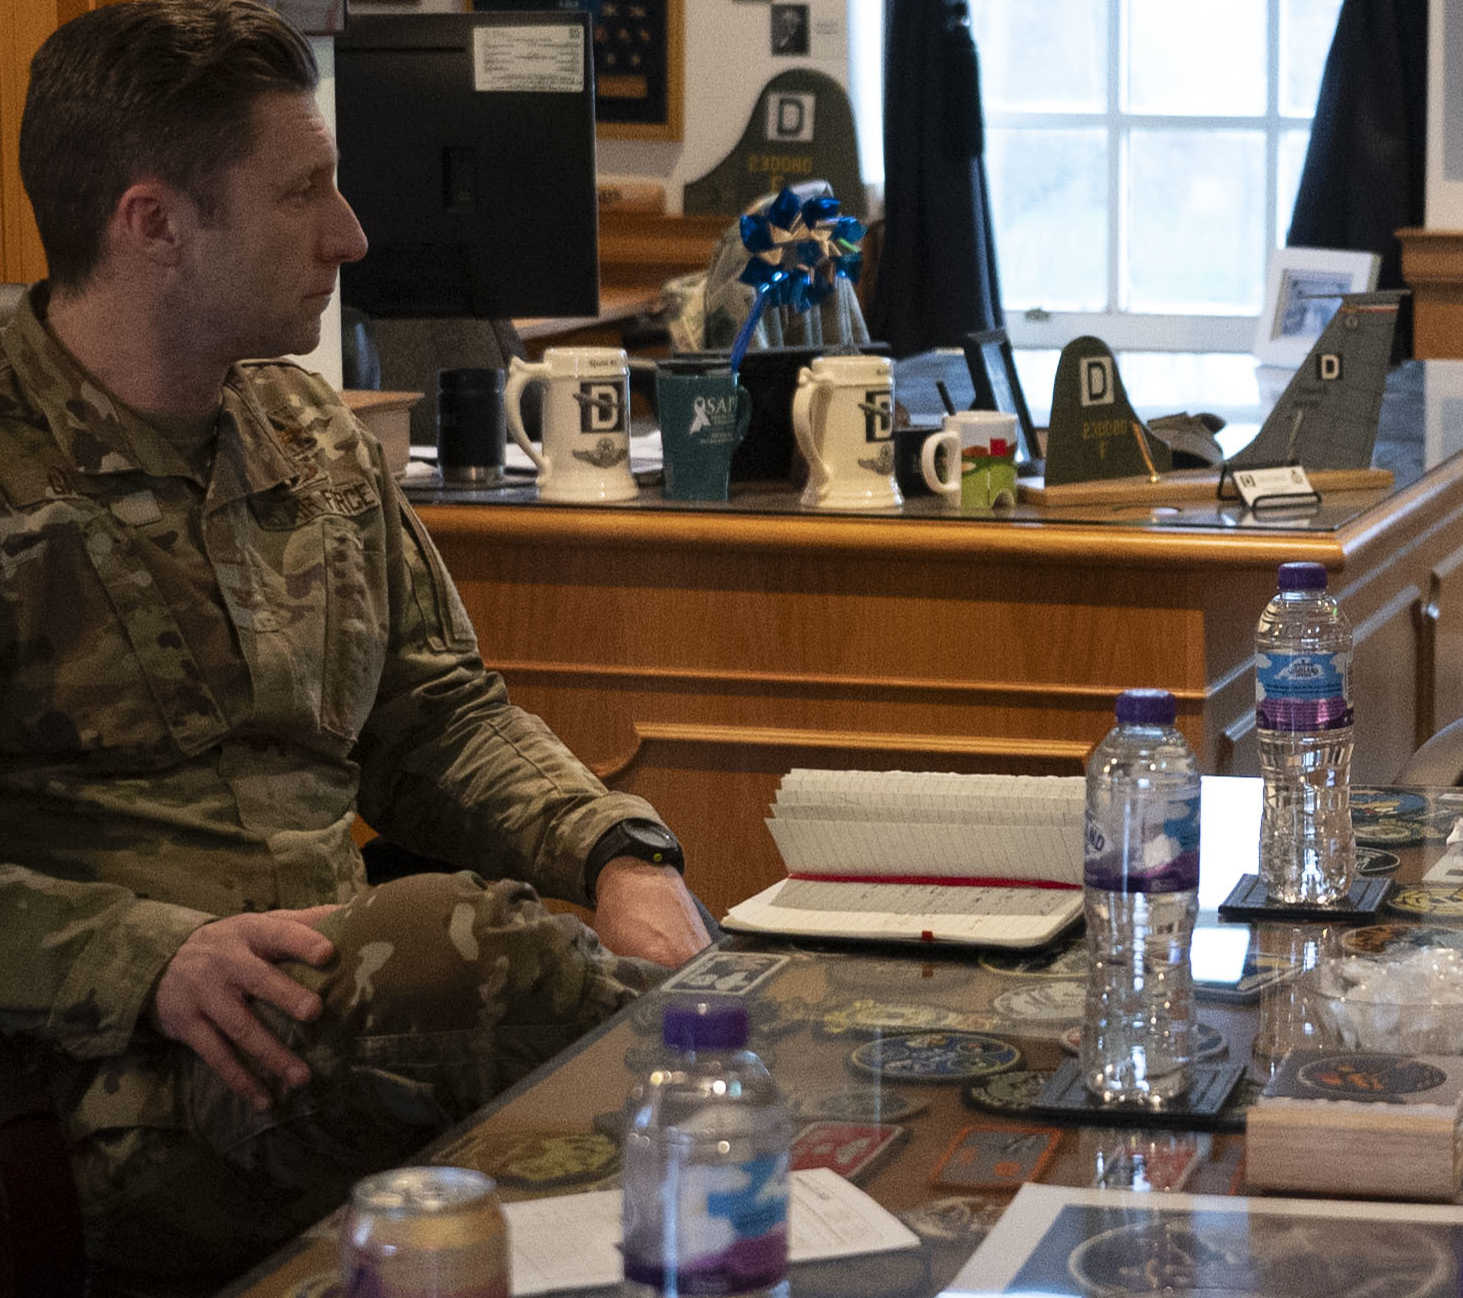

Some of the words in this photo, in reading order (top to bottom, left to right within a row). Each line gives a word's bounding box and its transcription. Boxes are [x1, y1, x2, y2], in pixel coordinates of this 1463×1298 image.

[778, 98, 804, 134] D
[1087, 361, 1107, 400] D
[1321, 354, 1339, 379] D
[591, 385, 618, 430] D
[324, 483, 375, 514] FRCE
